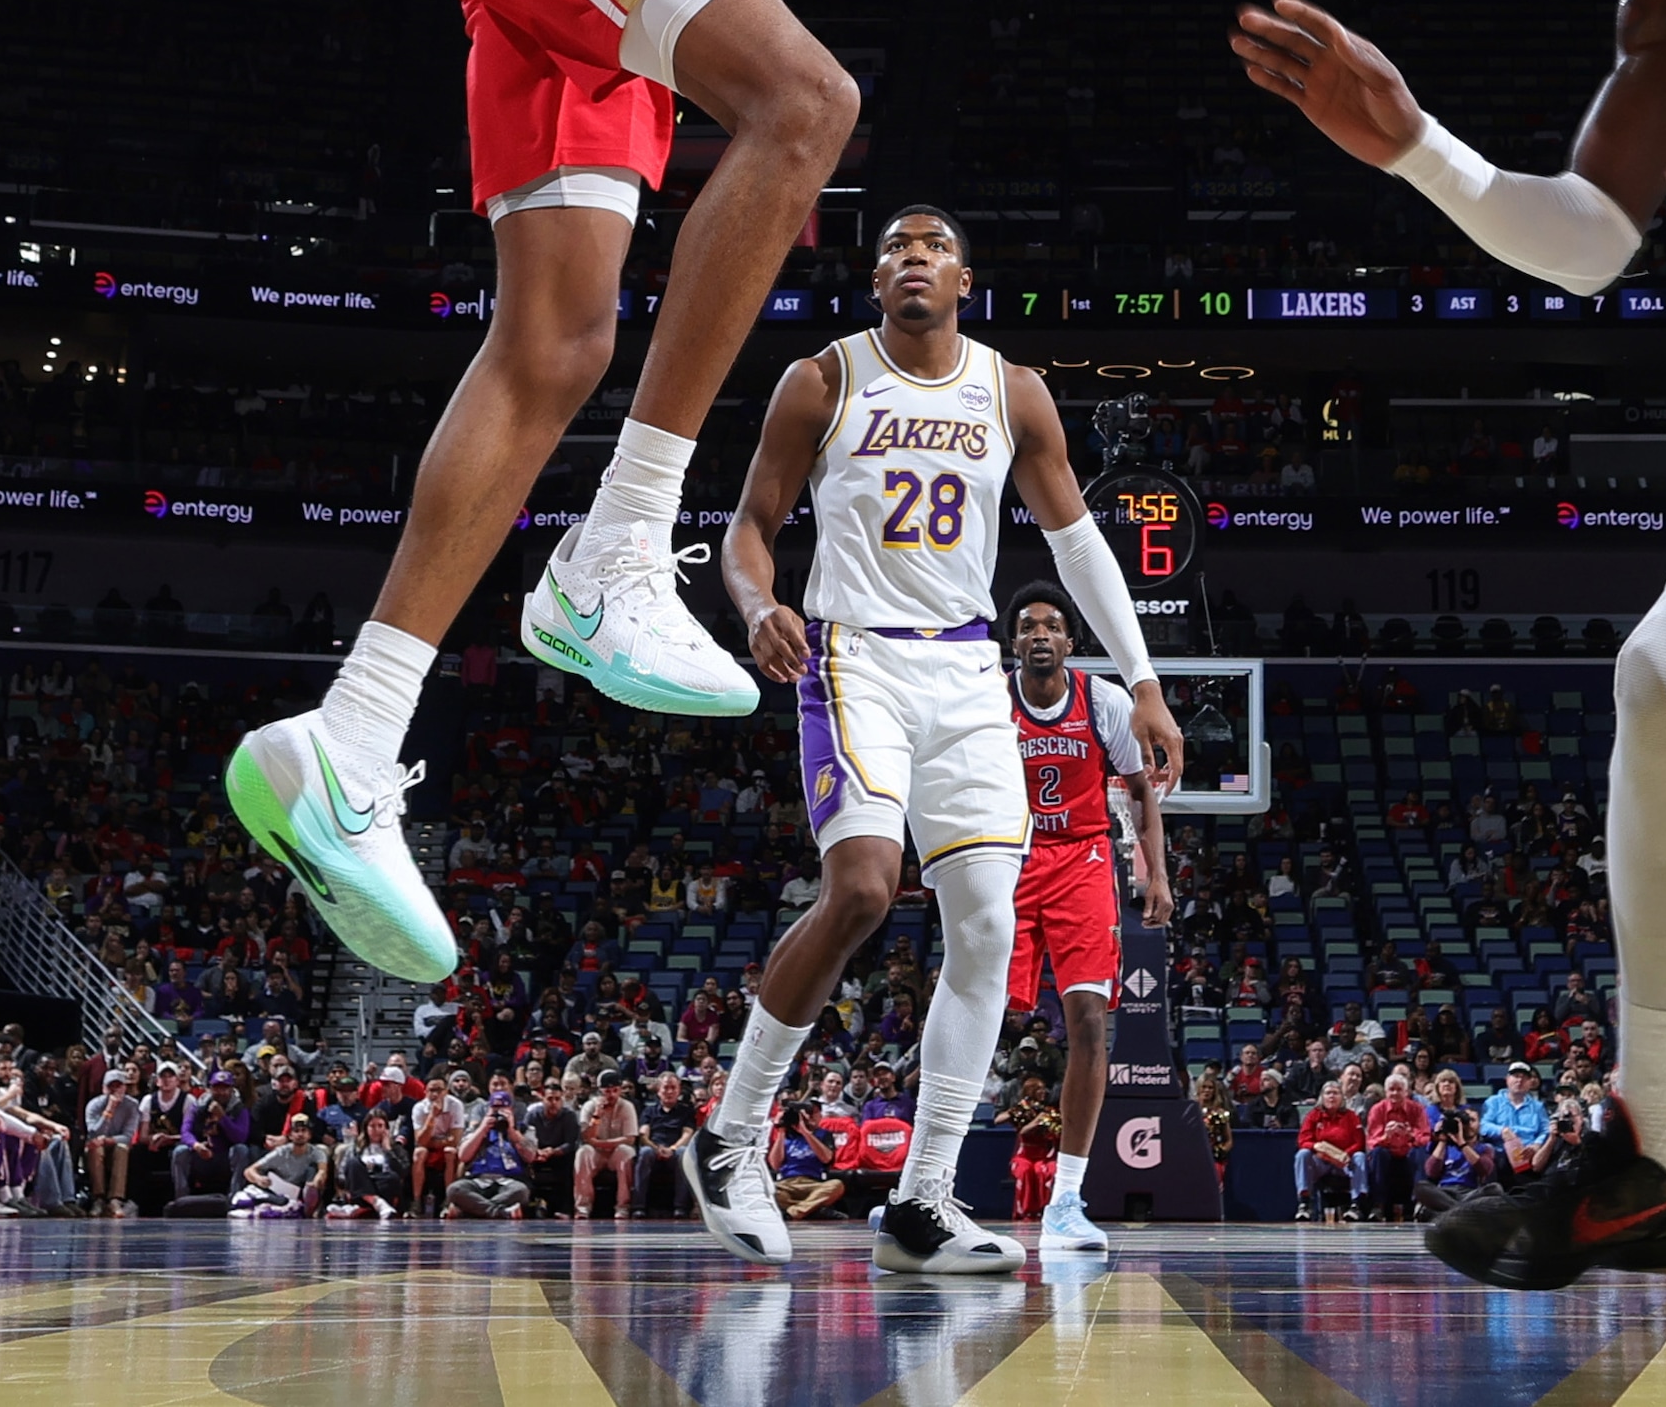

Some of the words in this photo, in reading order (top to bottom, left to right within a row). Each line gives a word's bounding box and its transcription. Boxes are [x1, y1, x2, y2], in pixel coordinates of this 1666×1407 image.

[7, 270, 38, 288] life.
[121, 281, 198, 305] entergy
[251, 286, 281, 304] We
[284, 290, 340, 308] power
[345, 293, 376, 310] life.
[646, 296, 658, 312] 7
[773, 297, 801, 311] AST
[830, 296, 839, 313] 1
[1022, 294, 1037, 315] 7
[1070, 297, 1091, 311] 1st
[1115, 294, 1164, 314] 7:57
[1199, 293, 1231, 315] 10
[1281, 292, 1366, 317] LAKERS
[1411, 295, 1423, 313] 3
[1450, 296, 1477, 310] AST
[1507, 295, 1519, 313] 3
[1544, 296, 1564, 310] RB
[1593, 296, 1605, 313] 7
[850, 409, 989, 460] LAKERS
[171, 499, 253, 524] entergy
[302, 502, 333, 522] We
[339, 507, 401, 526] power
[534, 509, 589, 526] enter
[882, 470, 967, 551] 28
[1118, 495, 1177, 522] 7:56
[1234, 510, 1313, 531] entergy
[1361, 507, 1392, 524] We
[1398, 510, 1460, 528] power
[1584, 509, 1664, 530] entergy
[1141, 524, 1173, 576] 6
[1425, 568, 1481, 613] 119
[1132, 600, 1189, 615] SSOT
[1018, 736, 1089, 760] RESCENT
[1038, 765, 1062, 806] 2
[1033, 809, 1070, 832] CITY
[1132, 1064, 1171, 1074] Keesler
[1132, 1075, 1170, 1085] Federal
[1116, 1116, 1162, 1169] G
